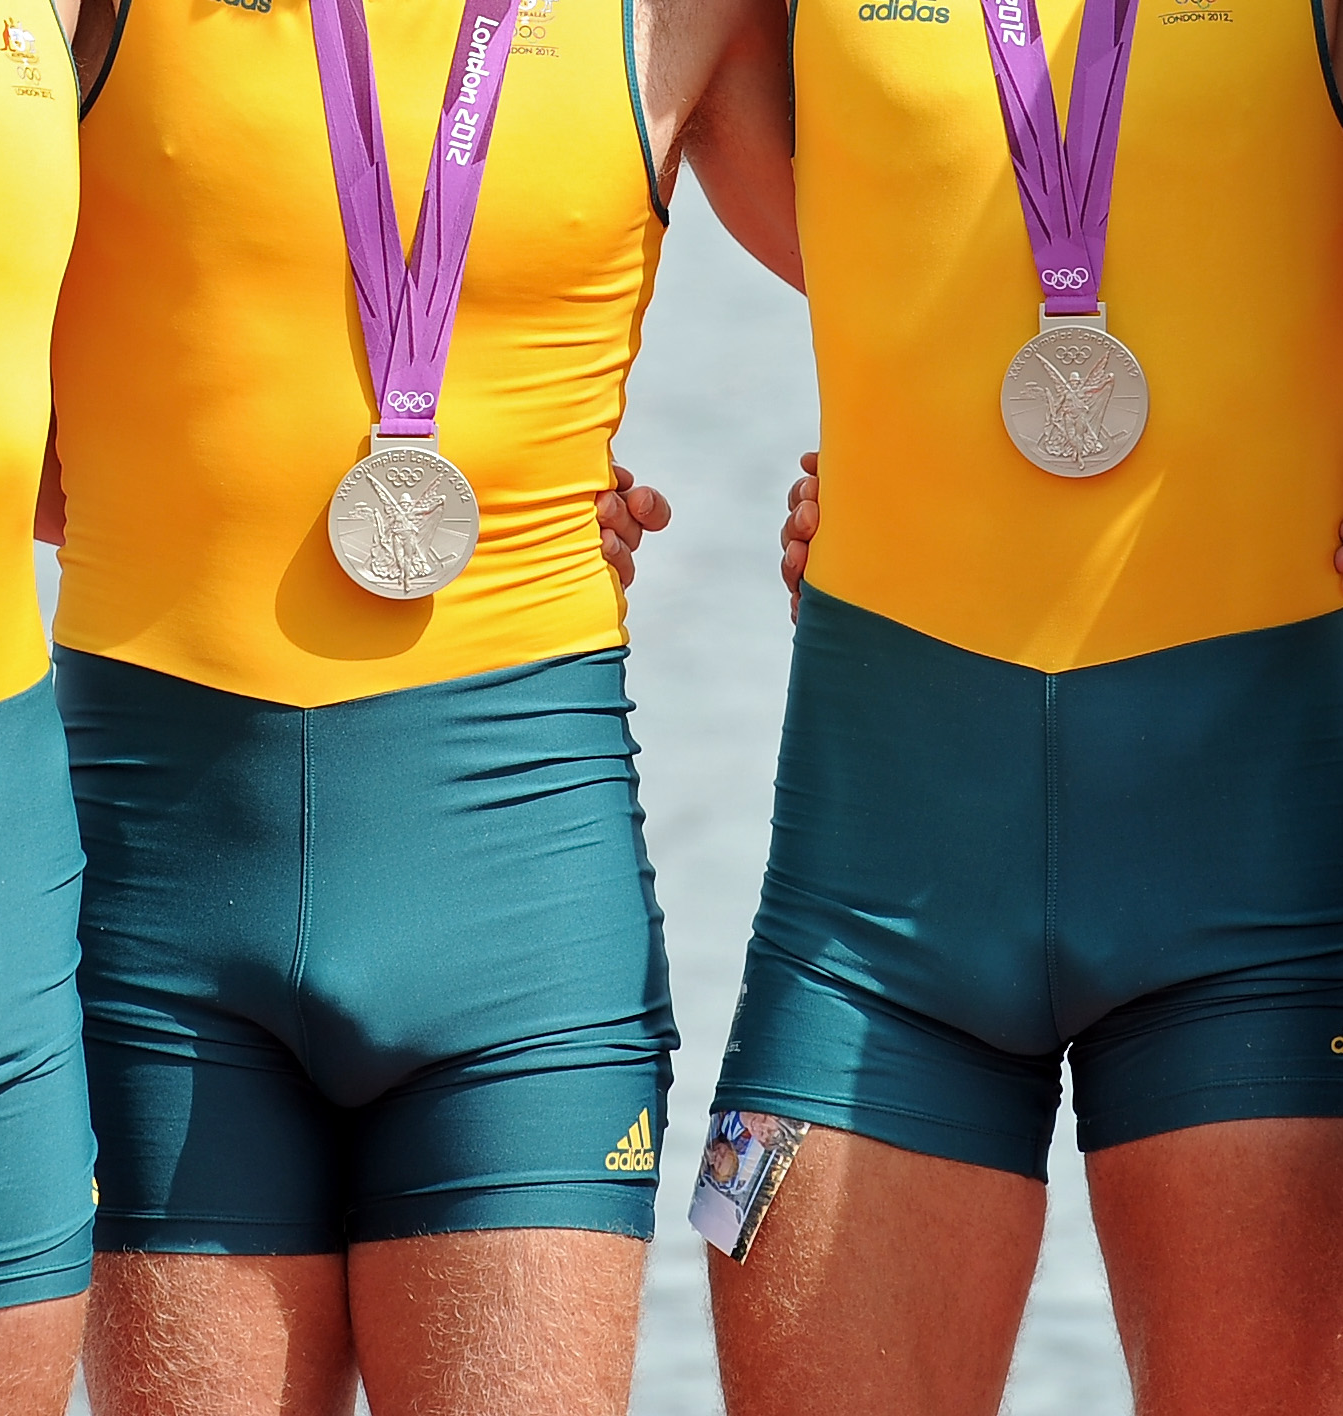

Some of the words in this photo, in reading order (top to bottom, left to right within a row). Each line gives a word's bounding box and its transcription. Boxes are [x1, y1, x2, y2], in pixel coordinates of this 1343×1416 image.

[858, 0, 950, 24] adidas
[1162, 13, 1205, 25] LONDON
[1207, 13, 1229, 22] 2012
[459, 15, 500, 104] London
[445, 108, 480, 166] 2012
[337, 476, 357, 501] XXX
[448, 473, 472, 503] 2012
[605, 1148, 655, 1171] adidas
